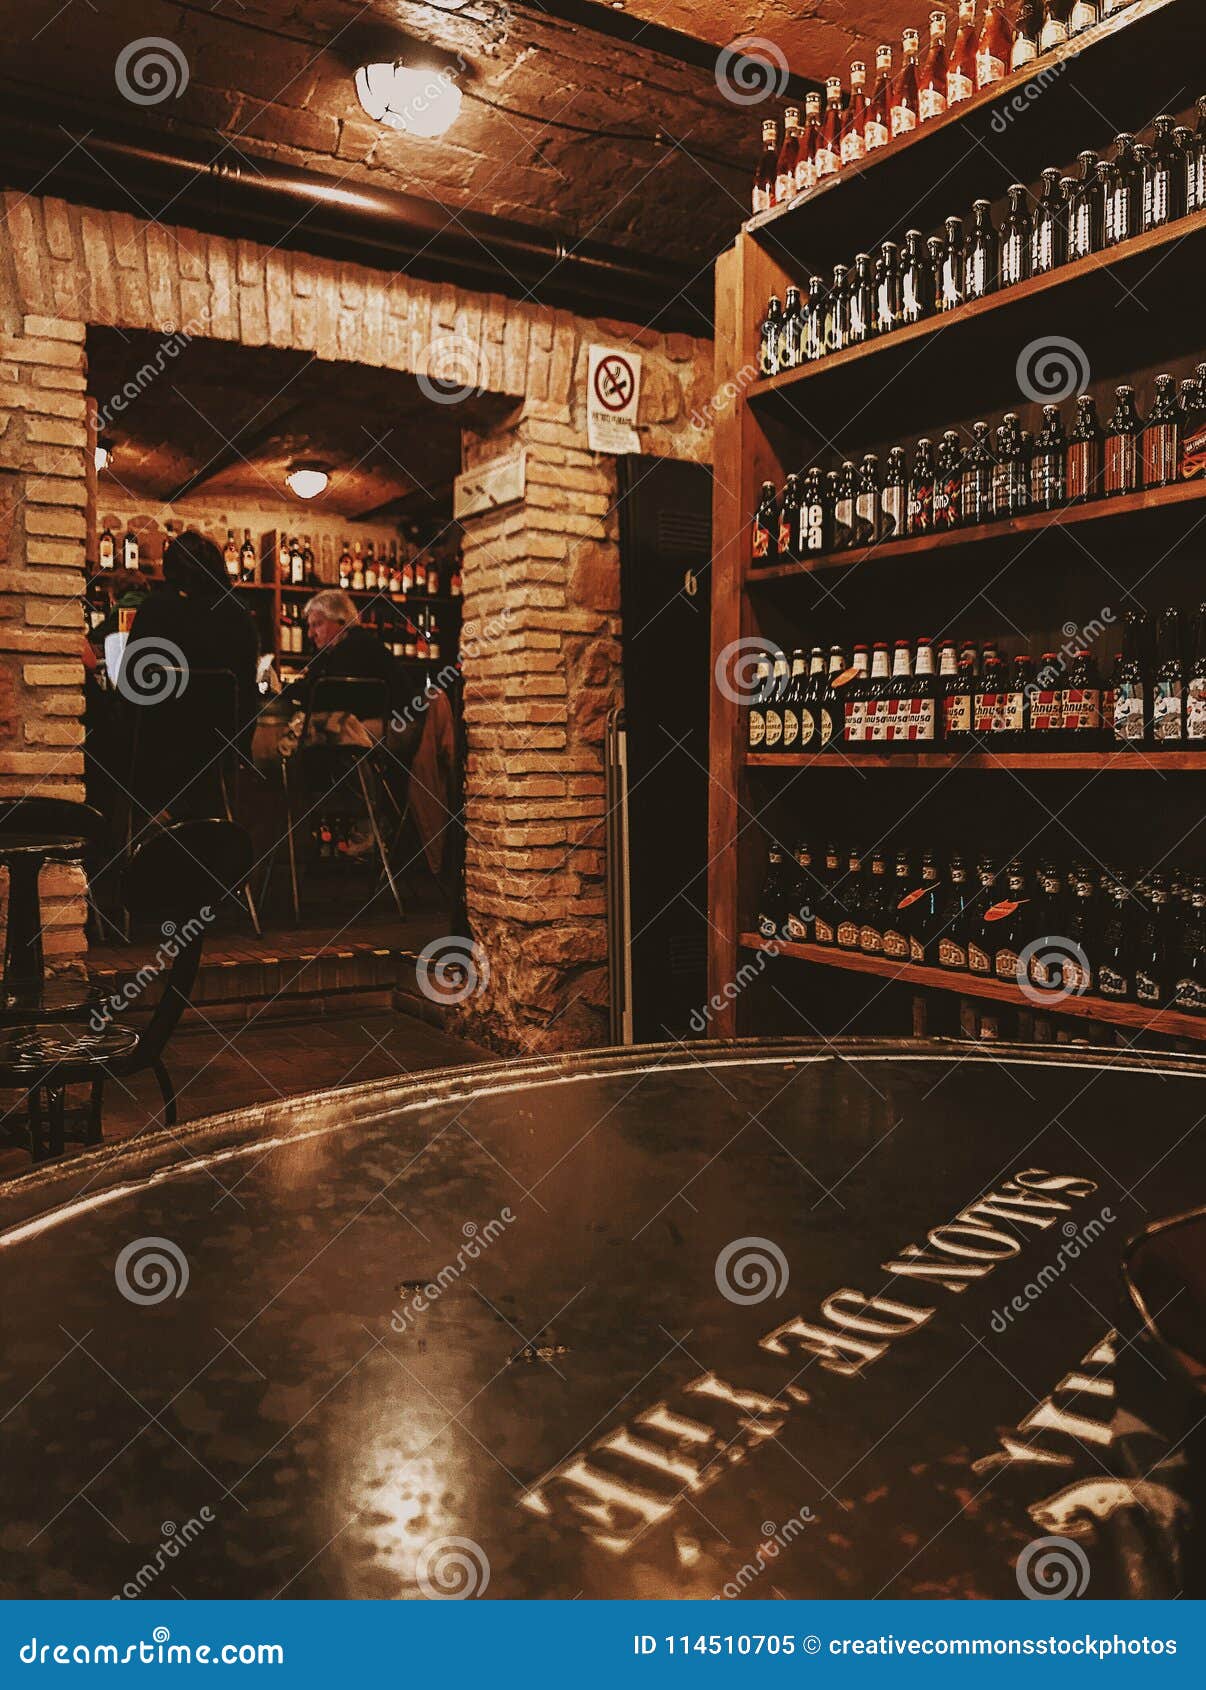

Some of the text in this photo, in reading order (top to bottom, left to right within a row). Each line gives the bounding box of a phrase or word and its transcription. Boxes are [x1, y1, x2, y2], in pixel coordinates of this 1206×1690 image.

[684, 568, 698, 596] 6
[880, 1168, 1098, 1294] SALON
[758, 1288, 938, 1378] DE
